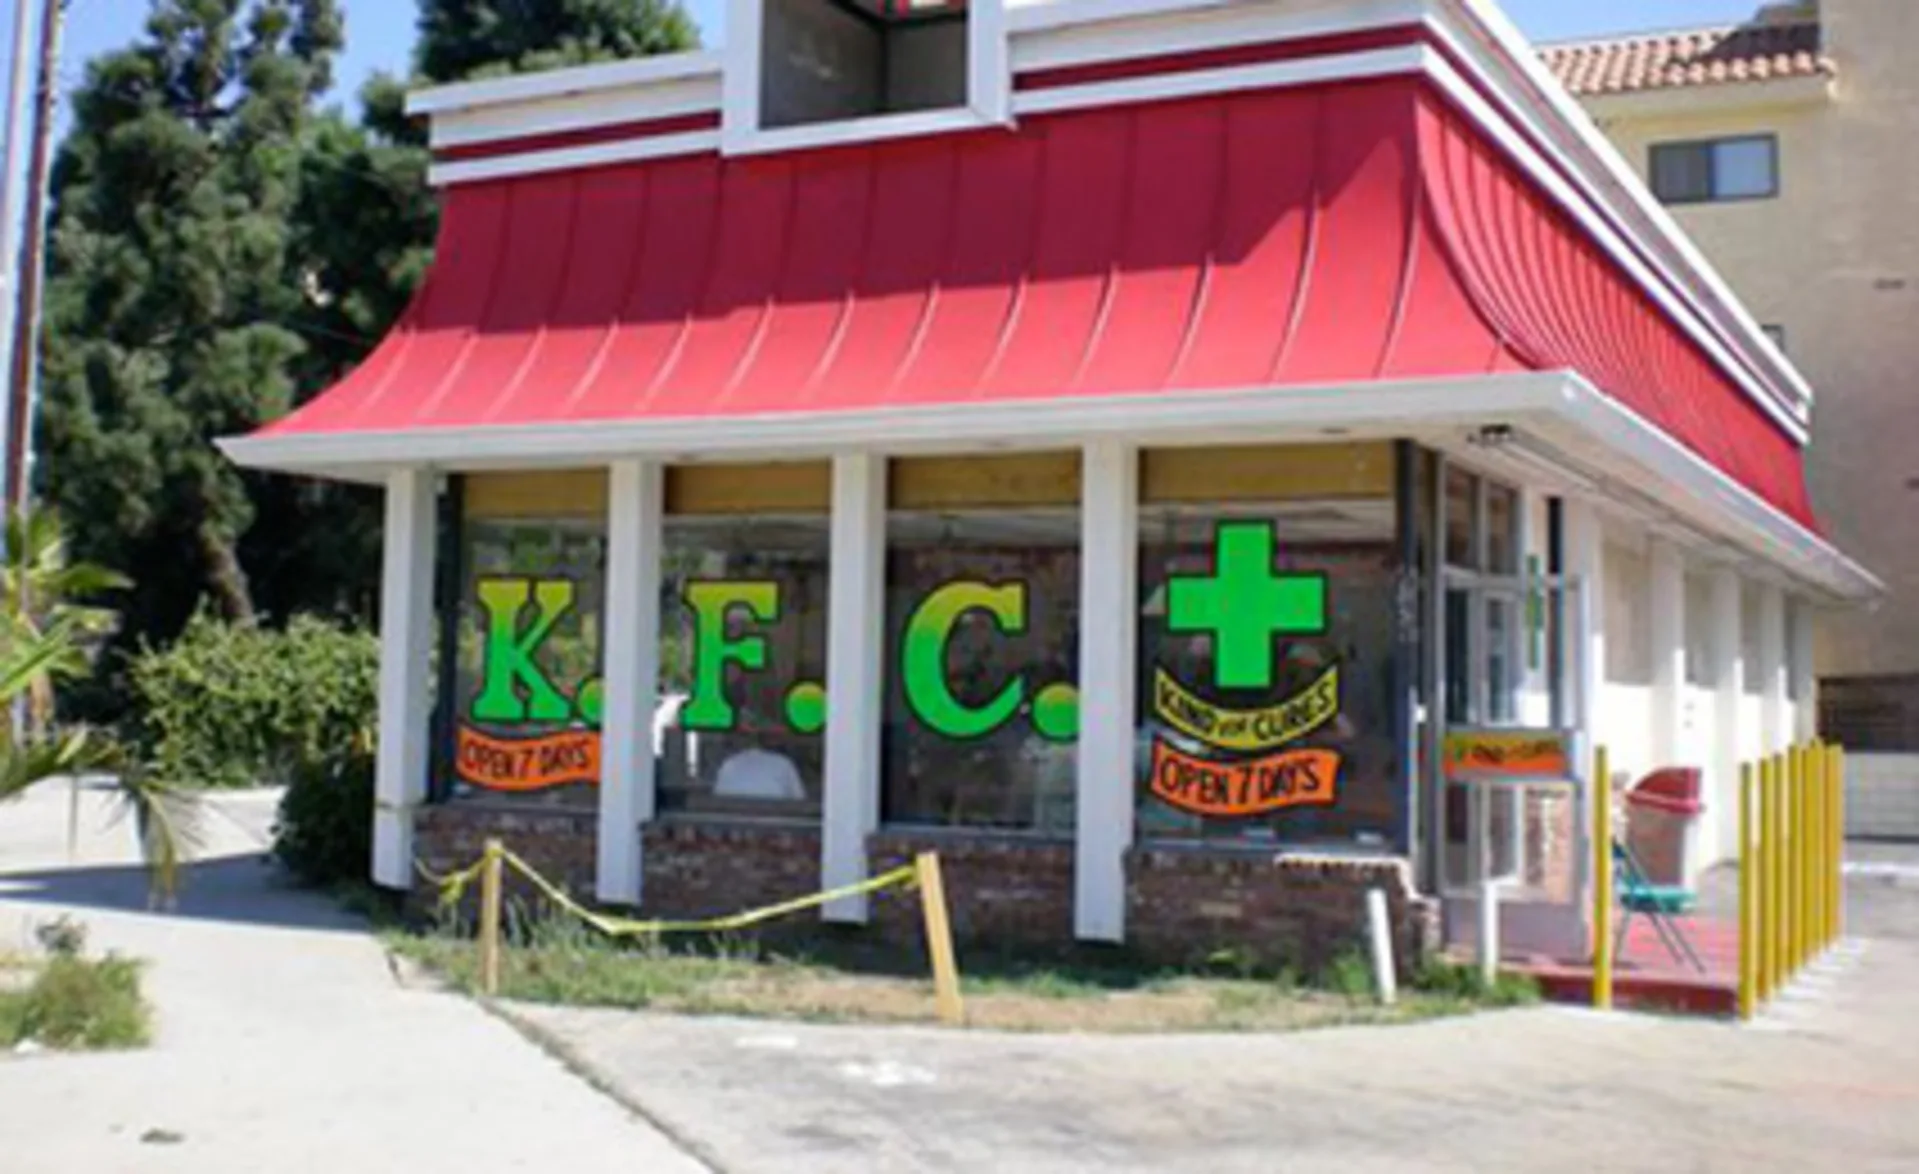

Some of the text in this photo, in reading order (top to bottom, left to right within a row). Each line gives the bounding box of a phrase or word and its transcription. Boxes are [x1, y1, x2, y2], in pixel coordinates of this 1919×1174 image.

[463, 738, 588, 779] OPEN 7 DAYS
[1160, 756, 1321, 805] OPEN 7 DAYS
